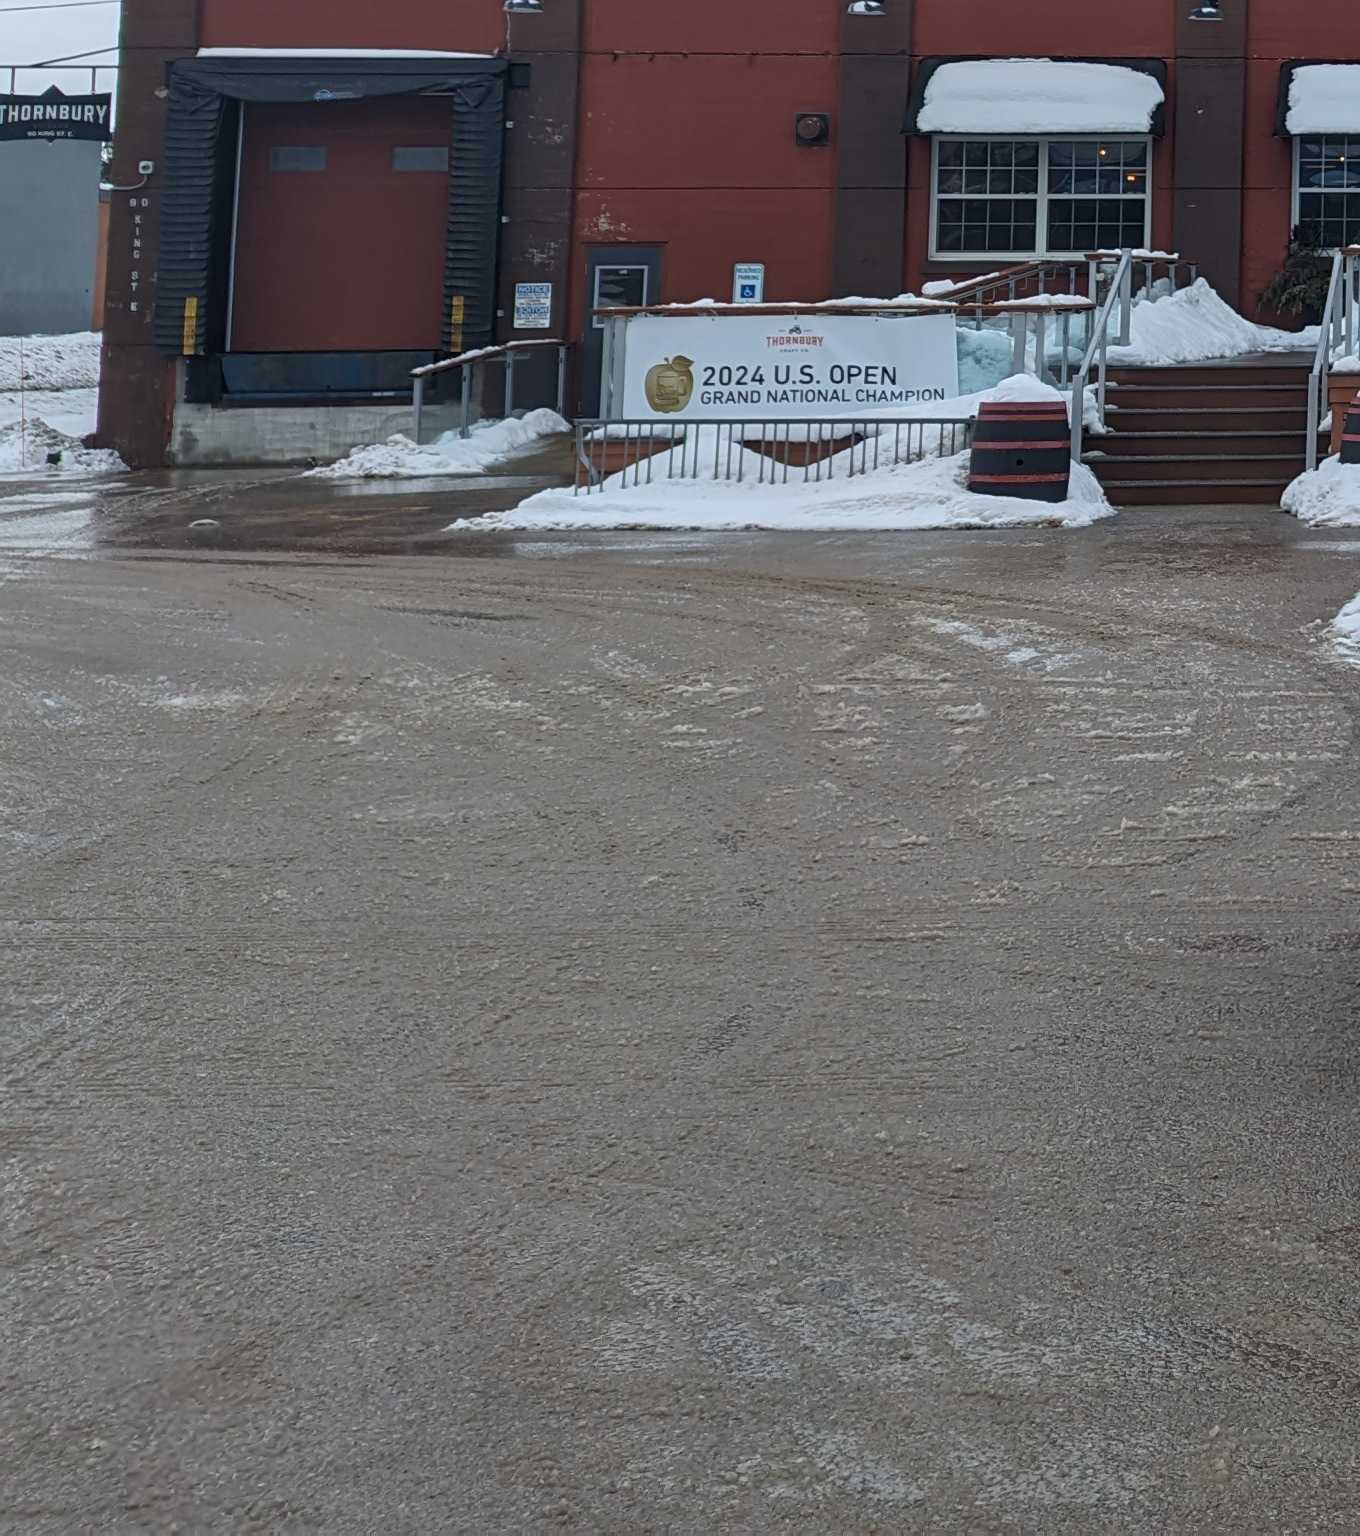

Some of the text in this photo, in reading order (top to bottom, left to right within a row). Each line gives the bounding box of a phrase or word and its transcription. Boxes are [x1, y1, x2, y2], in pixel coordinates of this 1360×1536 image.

[133, 215, 142, 259] KING
[130, 271, 139, 291] ST
[130, 302, 138, 312] E
[766, 335, 825, 348] THORNBURY
[702, 365, 897, 386] 2024 U.S. OPEN
[700, 387, 945, 405] GRAND NATIONAL CHAMPION
